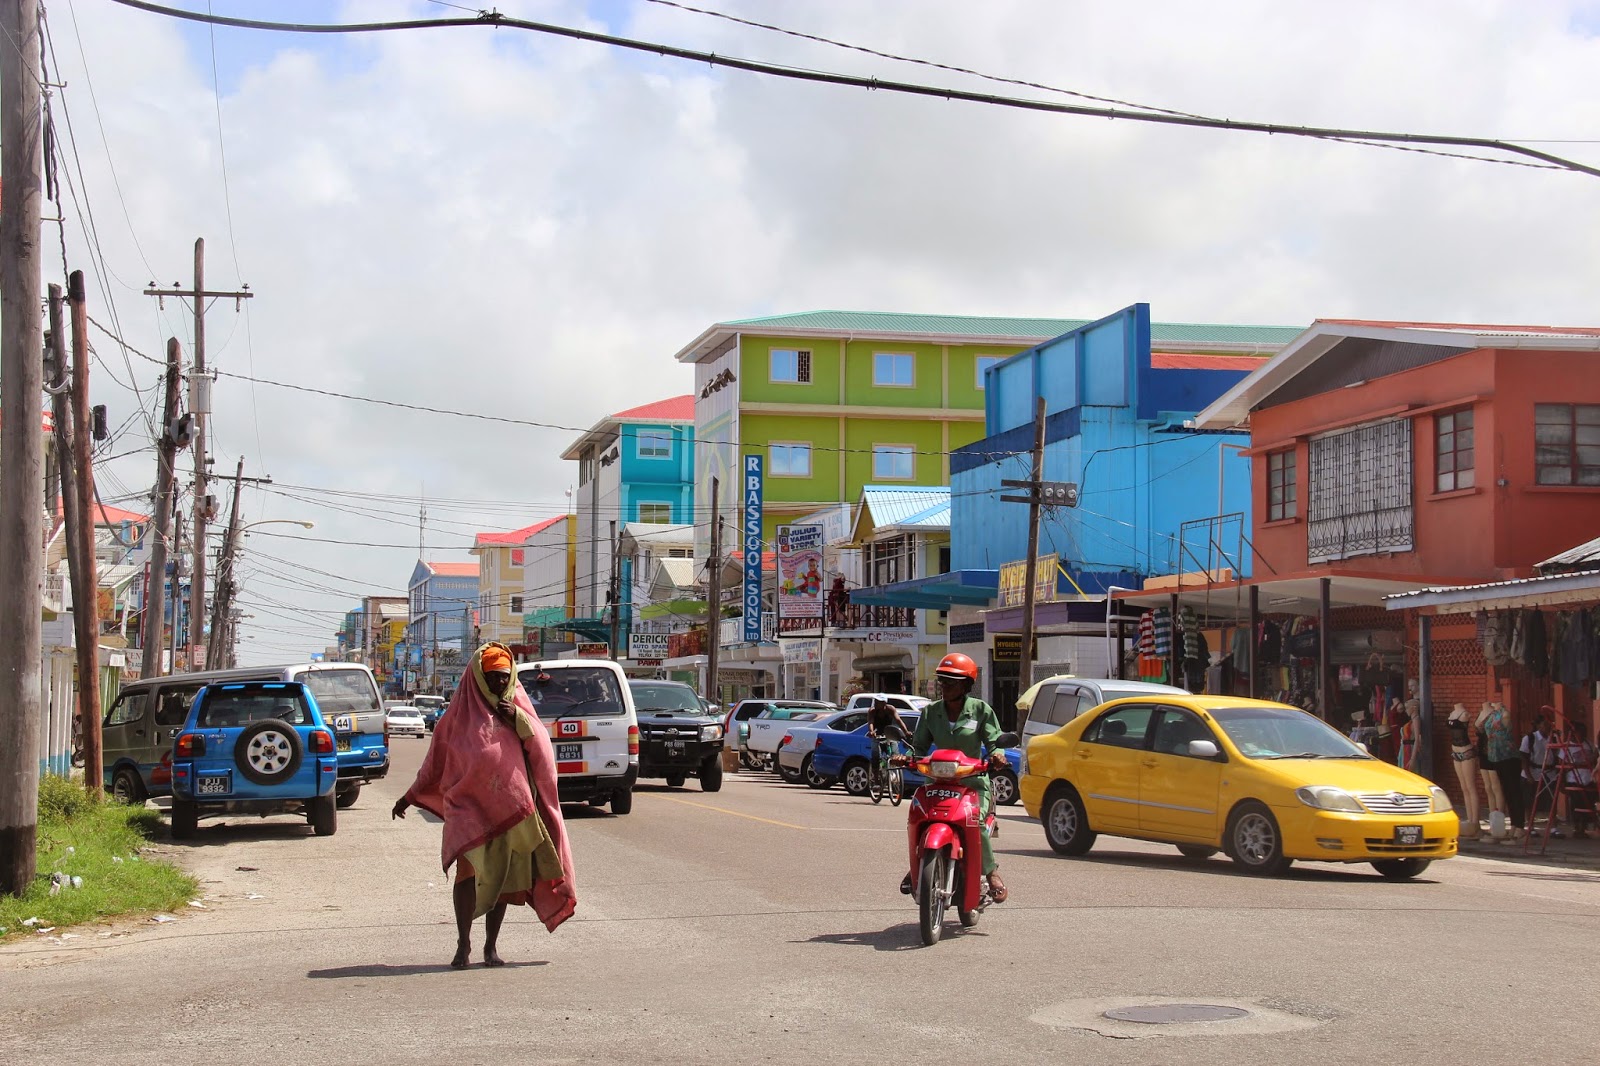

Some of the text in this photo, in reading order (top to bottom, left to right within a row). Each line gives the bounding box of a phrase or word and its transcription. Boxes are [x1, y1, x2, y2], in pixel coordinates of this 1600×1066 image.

[747, 457, 760, 472] R
[747, 476, 760, 566] BASSOO
[790, 526, 817, 537] JULIUS
[790, 532, 821, 543] VARIETY
[747, 569, 758, 580] &
[1037, 557, 1055, 582] HUT
[747, 583, 759, 629] SONS
[336, 718, 349, 728] 44
[563, 723, 576, 733] 40
[559, 751, 581, 759] 6831
[205, 778, 220, 786] PJJ
[202, 785, 225, 793] 9332
[925, 789, 961, 798] CF 3217
[1401, 835, 1417, 844] 497
